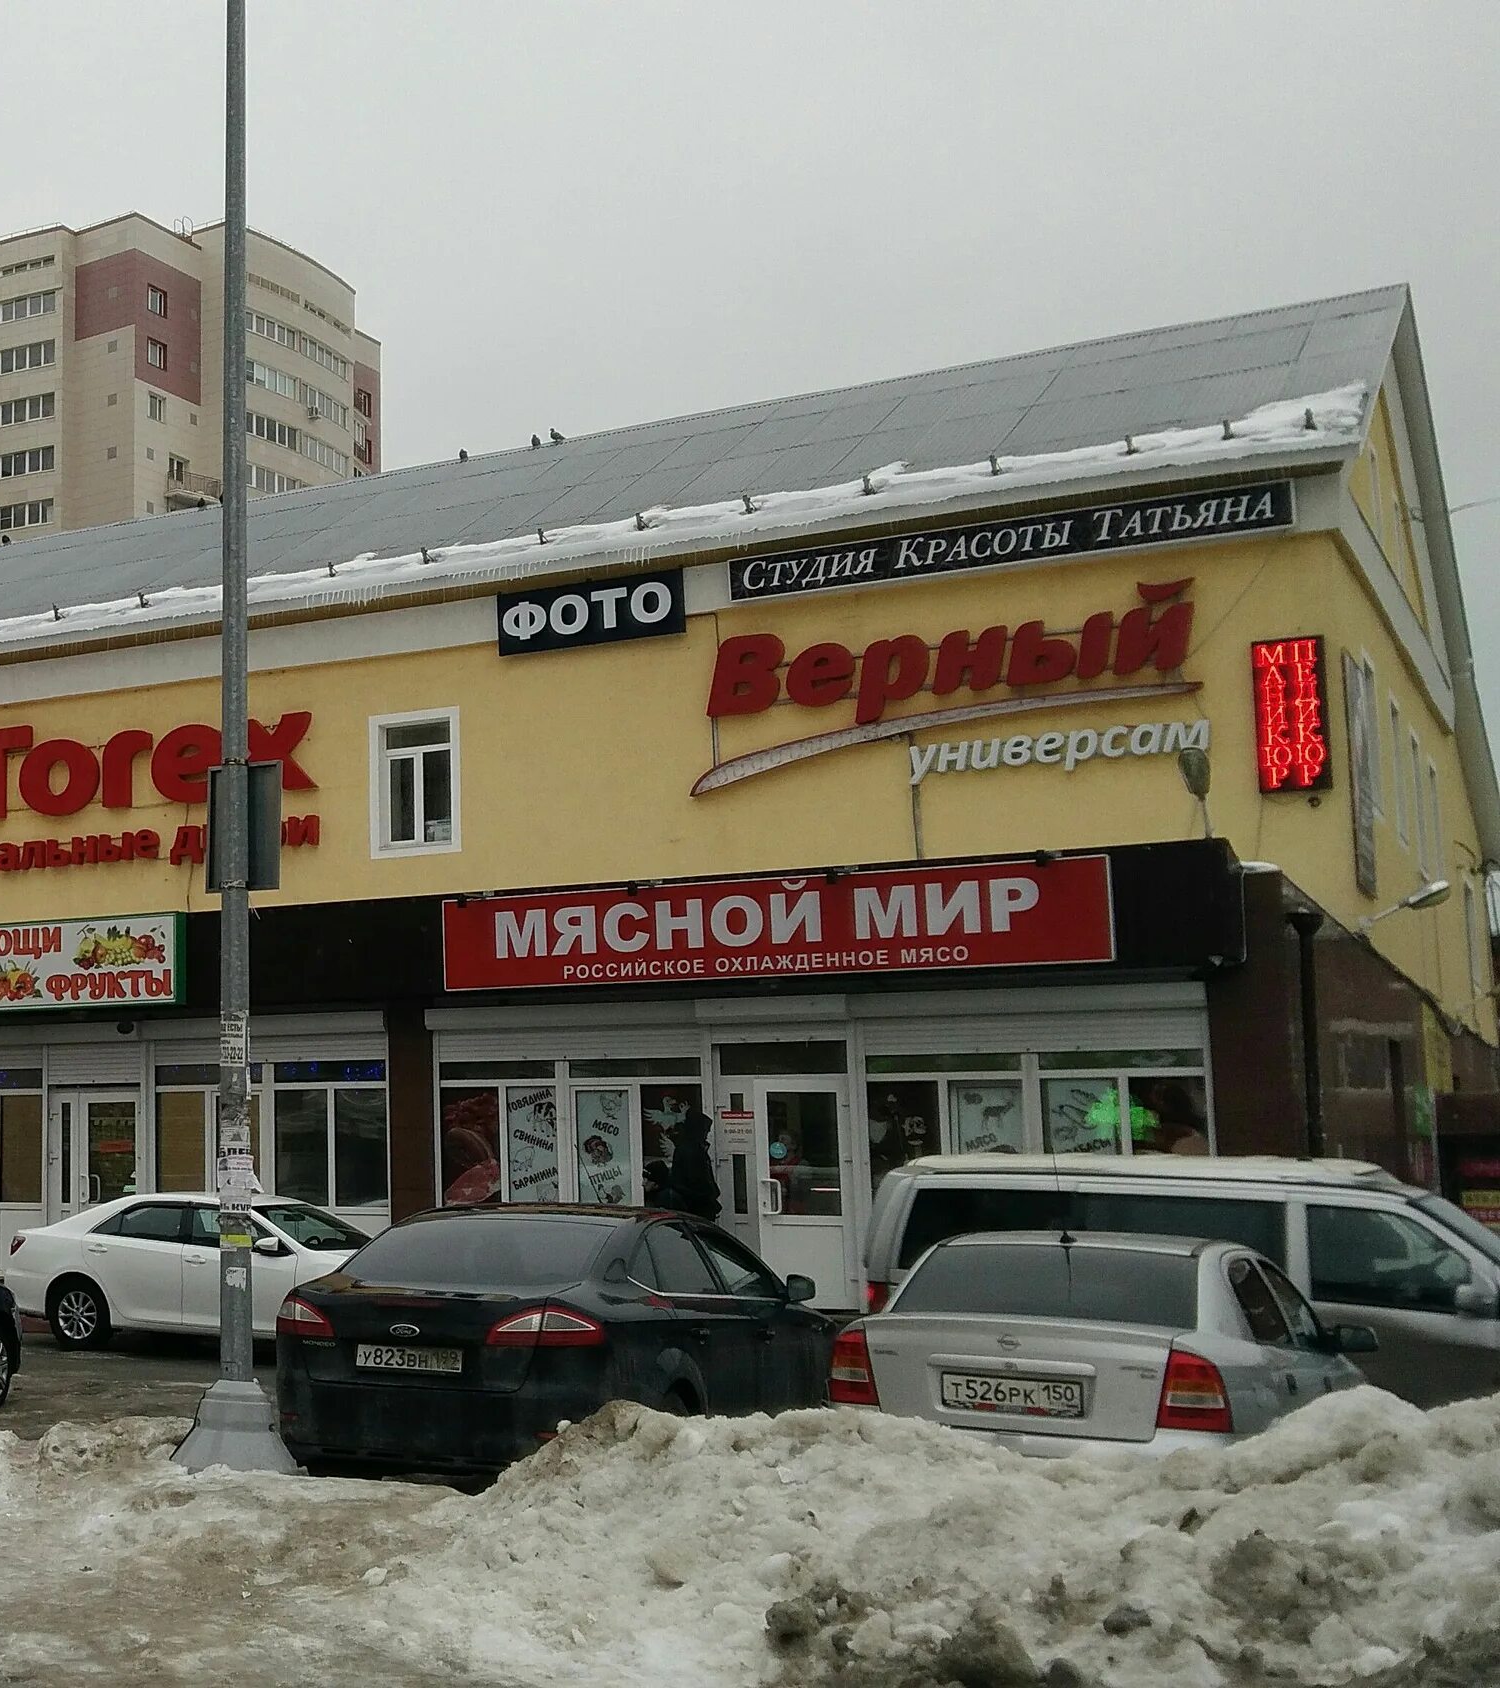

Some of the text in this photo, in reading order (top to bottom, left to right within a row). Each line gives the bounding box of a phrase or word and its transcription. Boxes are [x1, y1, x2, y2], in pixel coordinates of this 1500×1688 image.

[502, 582, 672, 640] ФОТО
[706, 576, 1195, 725] Верный
[1258, 644, 1292, 789] МАНИКЮР
[1292, 640, 1325, 786] ПЕДИКЮР
[909, 718, 1211, 784] универсам
[494, 876, 1040, 960] МЯСНОЙ МИР
[563, 945, 970, 981] РОССИЙСКОЕ ОХЛАЖДЕННОЕ МЯСО
[45, 967, 173, 1001] ФРУКТЫ
[513, 1129, 554, 1152] СВИНИНА
[592, 1119, 619, 1136] МЯСО
[512, 1166, 558, 1190] БАРАНИНА
[589, 1166, 622, 1185] ПТИЦЫ
[950, 1380, 1074, 1404] Т526РК 150
